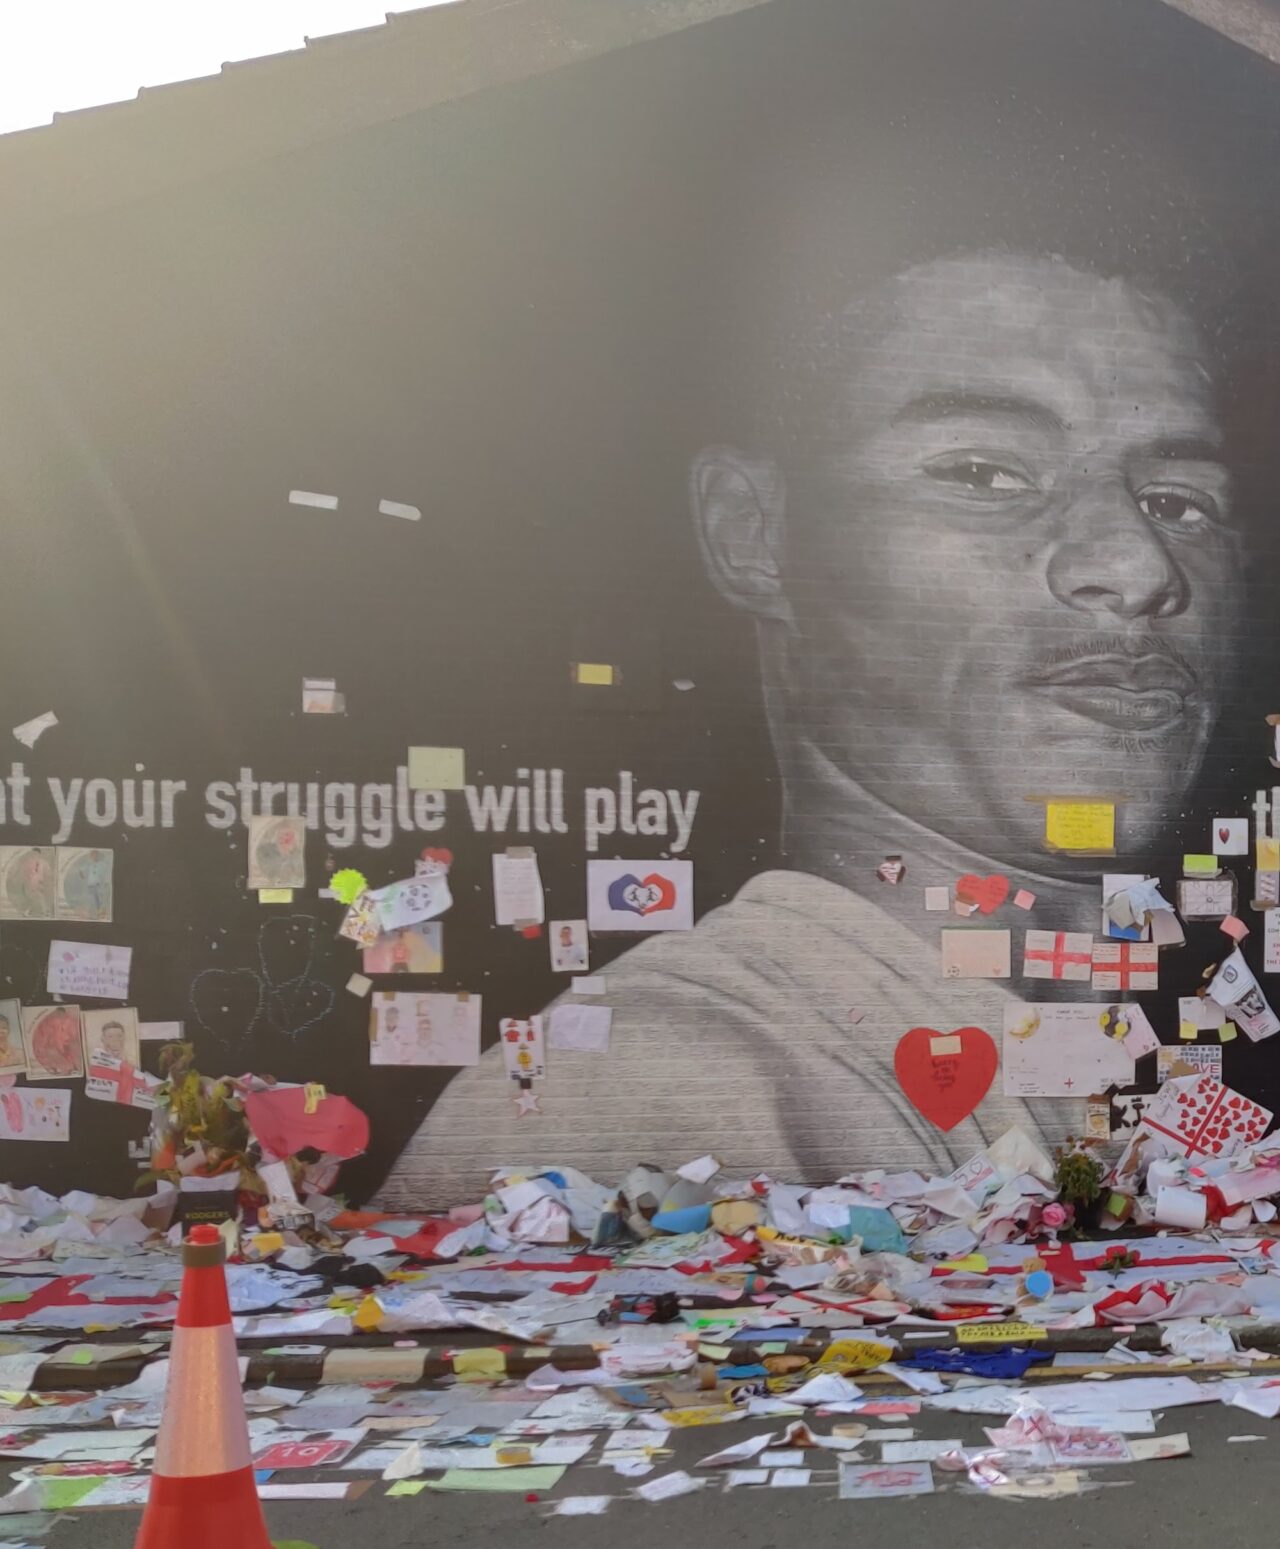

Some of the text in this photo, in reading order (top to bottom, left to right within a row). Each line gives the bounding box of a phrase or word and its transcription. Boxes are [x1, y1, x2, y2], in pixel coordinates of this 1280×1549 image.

[0, 762, 700, 852] t your struggle will play
